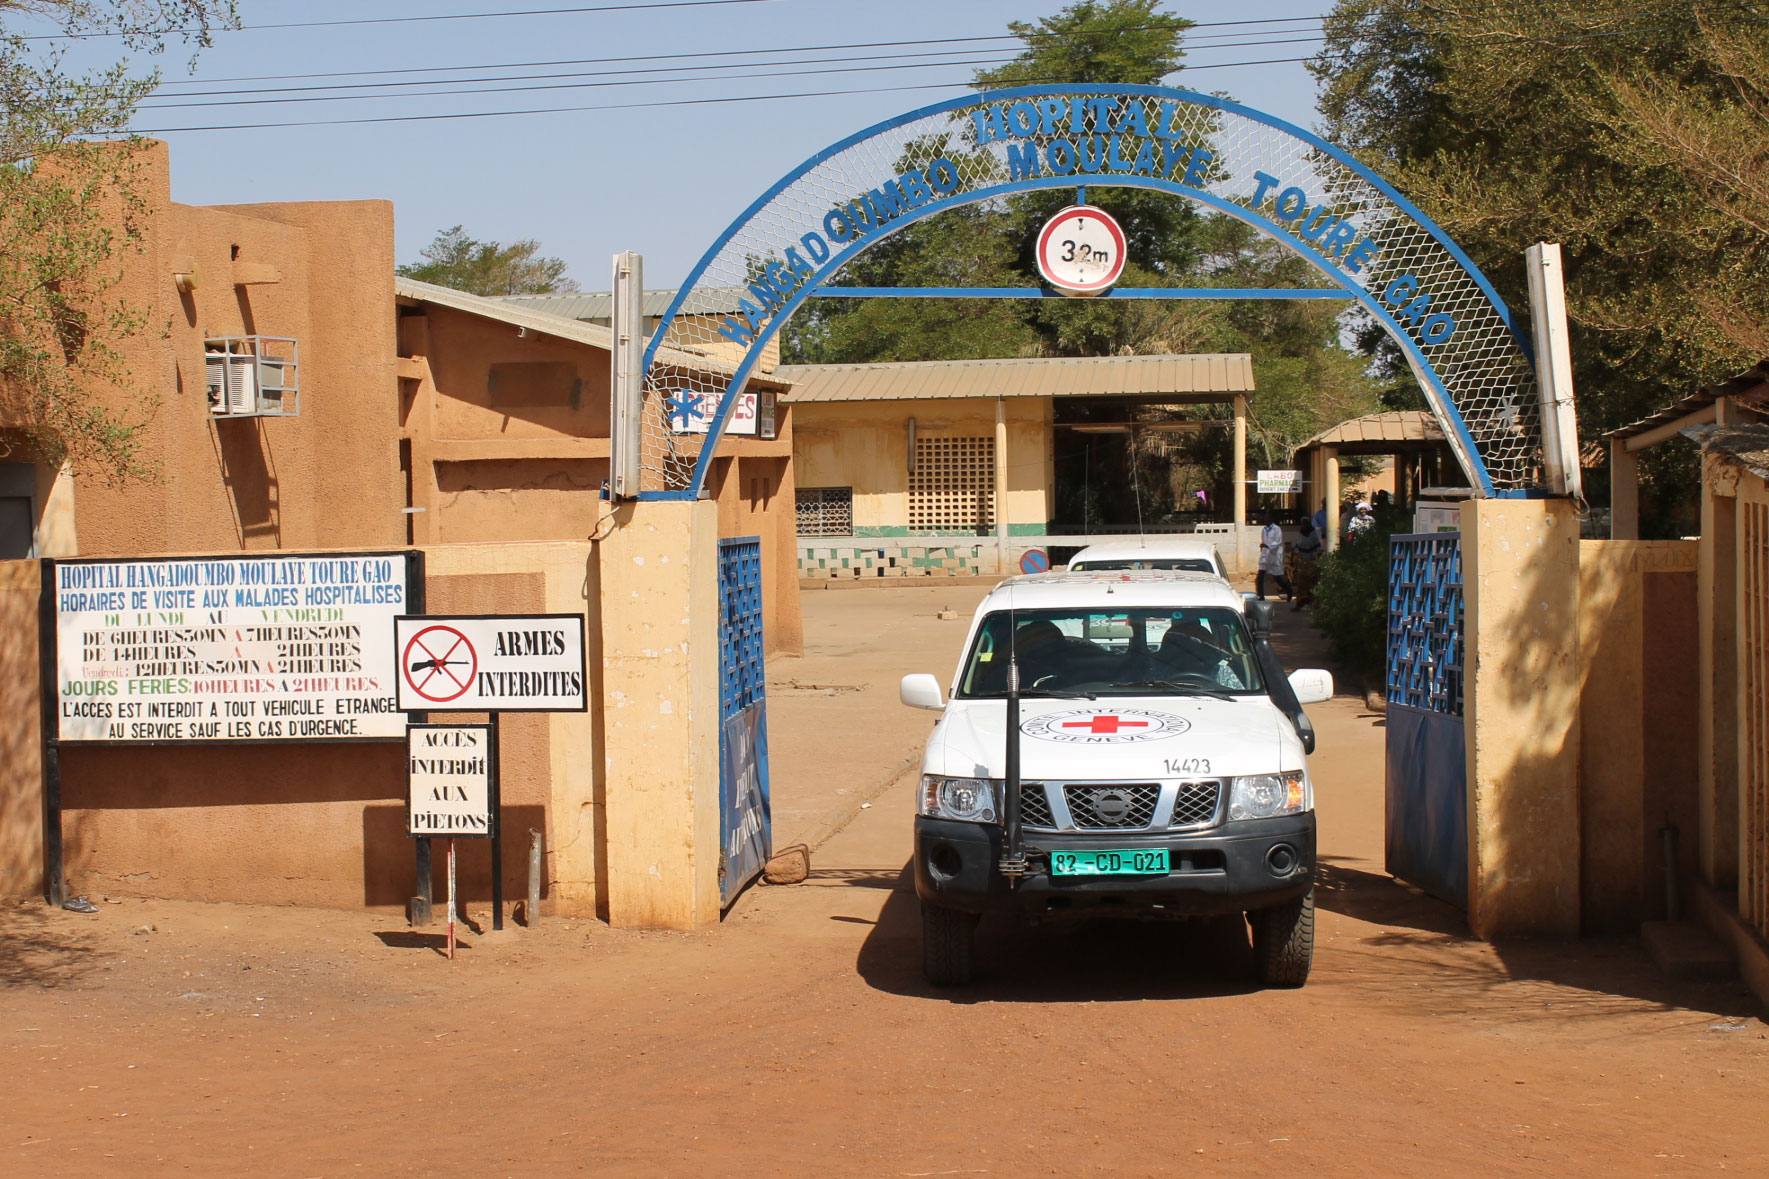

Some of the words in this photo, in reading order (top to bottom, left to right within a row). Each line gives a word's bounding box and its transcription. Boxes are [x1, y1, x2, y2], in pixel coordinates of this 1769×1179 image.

[971, 98, 1183, 144] HOPITAL
[718, 159, 959, 347] HANGADOUMBO
[1007, 134, 1213, 186] MOULAYE
[1249, 170, 1379, 274] TOURE
[1384, 274, 1455, 345] GAO
[61, 565, 123, 589] HOPITAL
[126, 562, 236, 588] HANGADOUMBO
[239, 561, 306, 586] MOULAYE
[309, 560, 359, 585] TOURE
[362, 559, 392, 584] GAO
[60, 592, 126, 612] HORAIRES
[131, 590, 148, 610] DE
[154, 590, 196, 609] VISITE
[203, 588, 229, 609] AUX
[235, 587, 299, 608] MALADES
[305, 584, 403, 606] HOSPITALISES
[105, 613, 125, 627] DU
[137, 611, 184, 627] LUNDI
[206, 609, 228, 625] AU
[260, 607, 344, 623] VENDREDI
[83, 631, 105, 646] DE
[232, 628, 243, 642] A
[493, 630, 566, 657] ARMES
[83, 647, 106, 662] DE
[114, 645, 196, 662] 14HEURES
[231, 645, 242, 658] A
[277, 642, 361, 657] 21HEURES
[265, 661, 275, 673] A
[277, 658, 362, 674] 21HEURES
[62, 679, 119, 697] JOURS
[278, 679, 289, 693] A
[478, 671, 581, 697] INTERDITES
[63, 701, 113, 718] L'ACCES
[118, 702, 142, 718] EST
[148, 701, 204, 718] INTERDIT
[210, 701, 218, 717] A
[224, 700, 256, 717] TOUT
[263, 699, 325, 716] VEHICULE
[109, 722, 125, 739] AU
[131, 722, 183, 739] SERVICE
[189, 721, 222, 738] SAUF
[228, 721, 252, 738] LES
[258, 720, 282, 737] CAS
[289, 719, 362, 736] D'URGENCE.
[1026, 715, 1058, 736] COMITE
[1068, 709, 1186, 735] INTERNATIONAL
[421, 730, 477, 748] ACCÈS
[1053, 734, 1155, 744] GENEVE
[1163, 758, 1212, 775] 14423
[429, 786, 469, 802] AUX
